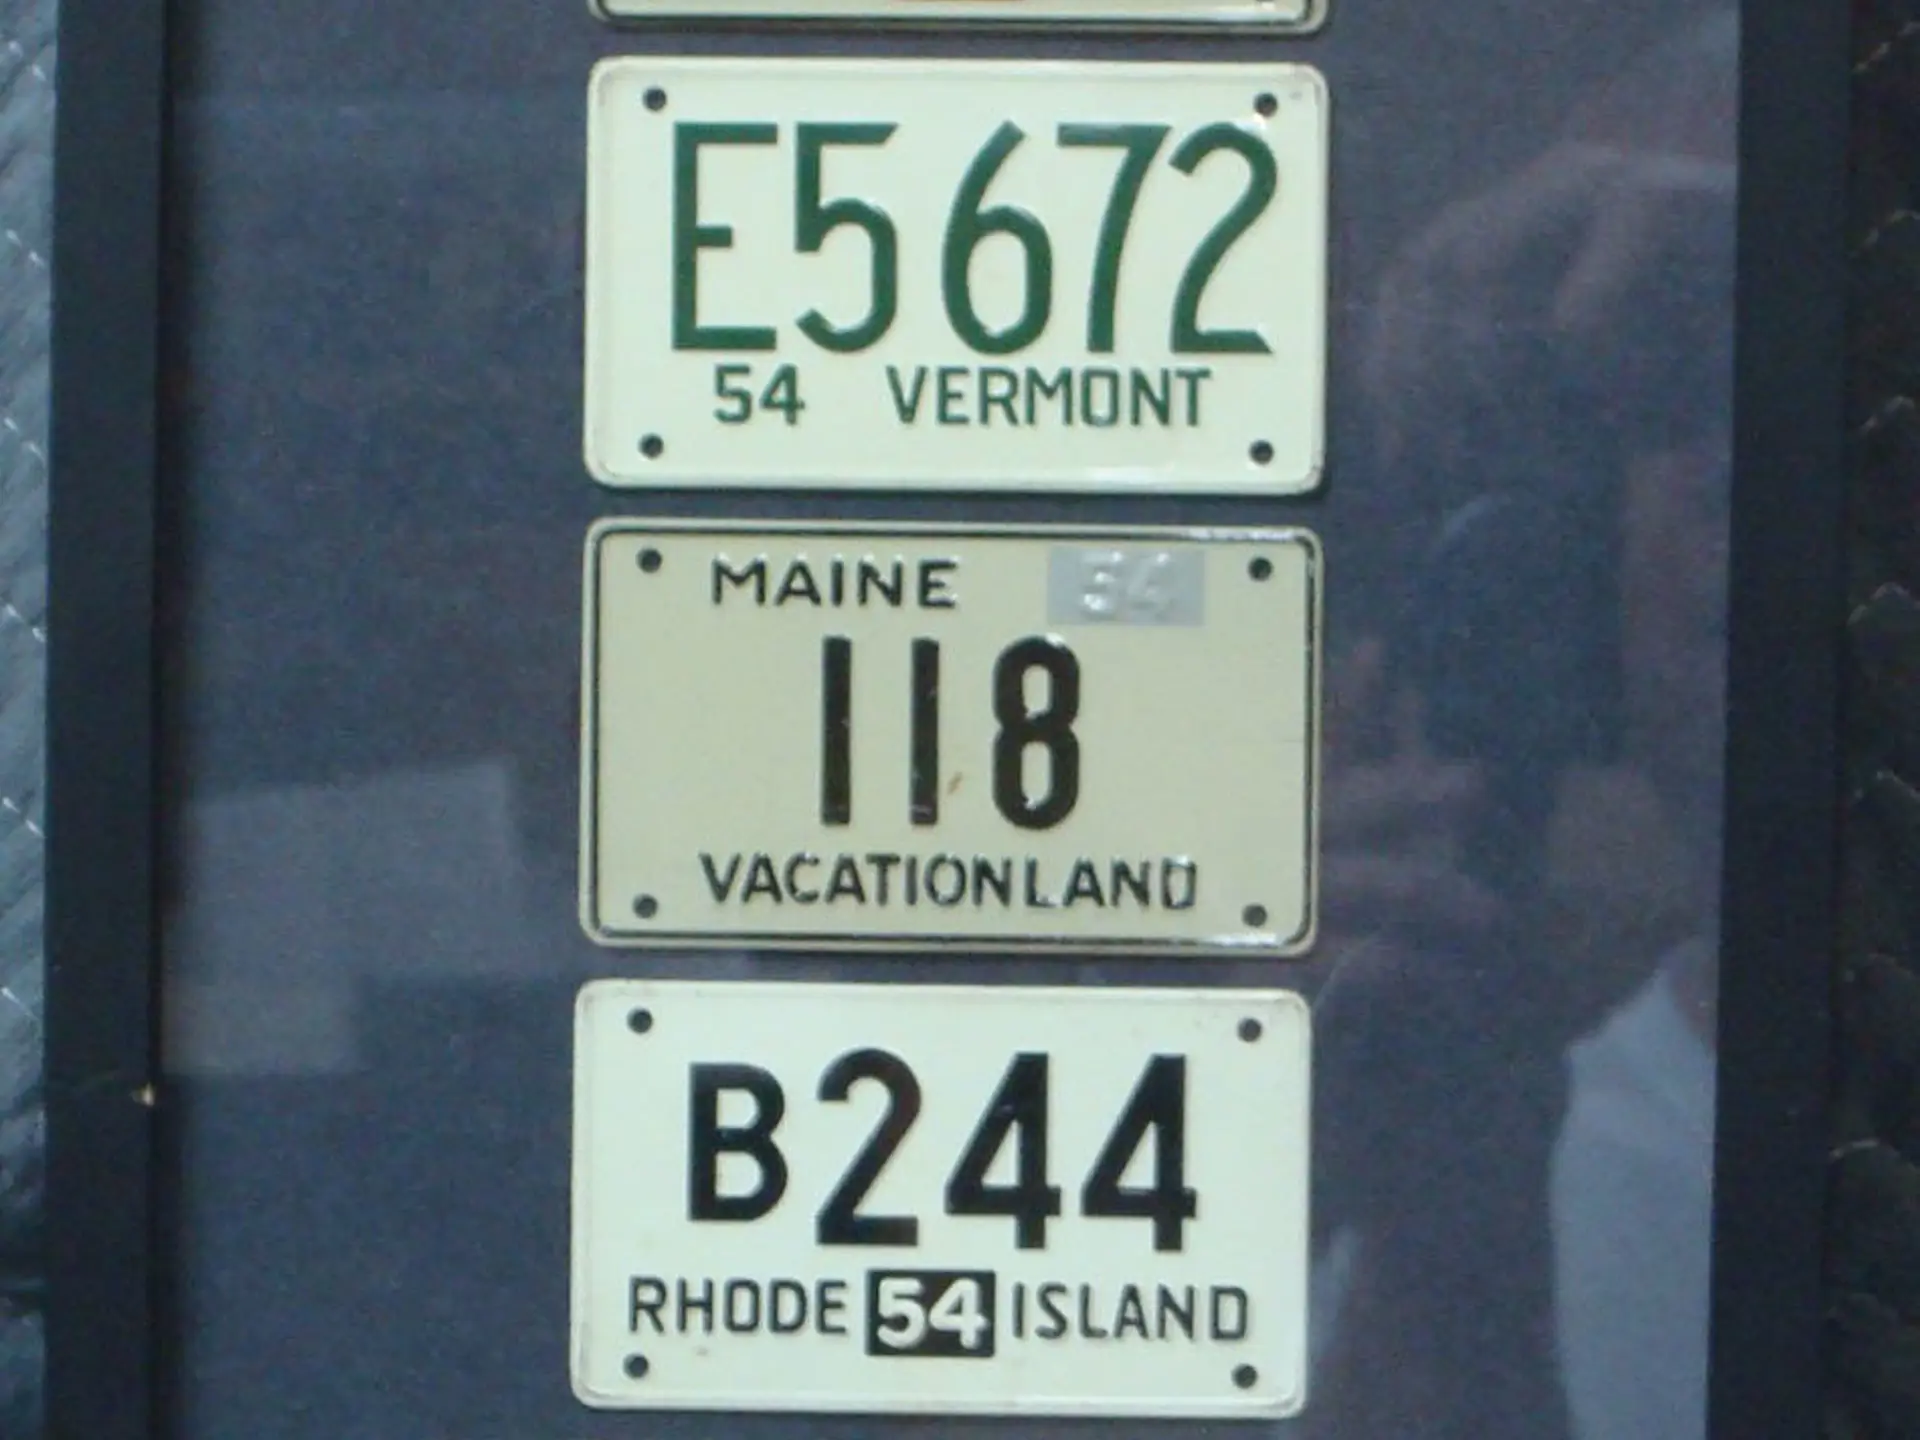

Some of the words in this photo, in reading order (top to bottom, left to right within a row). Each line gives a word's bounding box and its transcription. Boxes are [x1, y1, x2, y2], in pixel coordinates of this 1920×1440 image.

[713, 365, 805, 426] 54
[887, 367, 1211, 428] VERMONT
[712, 557, 958, 609] MAINE
[821, 634, 1080, 829] 118
[699, 852, 1198, 910] VACATIONLAND
[687, 1047, 1198, 1252] B244
[627, 1277, 848, 1335] RHODE
[877, 1277, 988, 1349] 54
[1012, 1284, 1249, 1341] ISLAND
